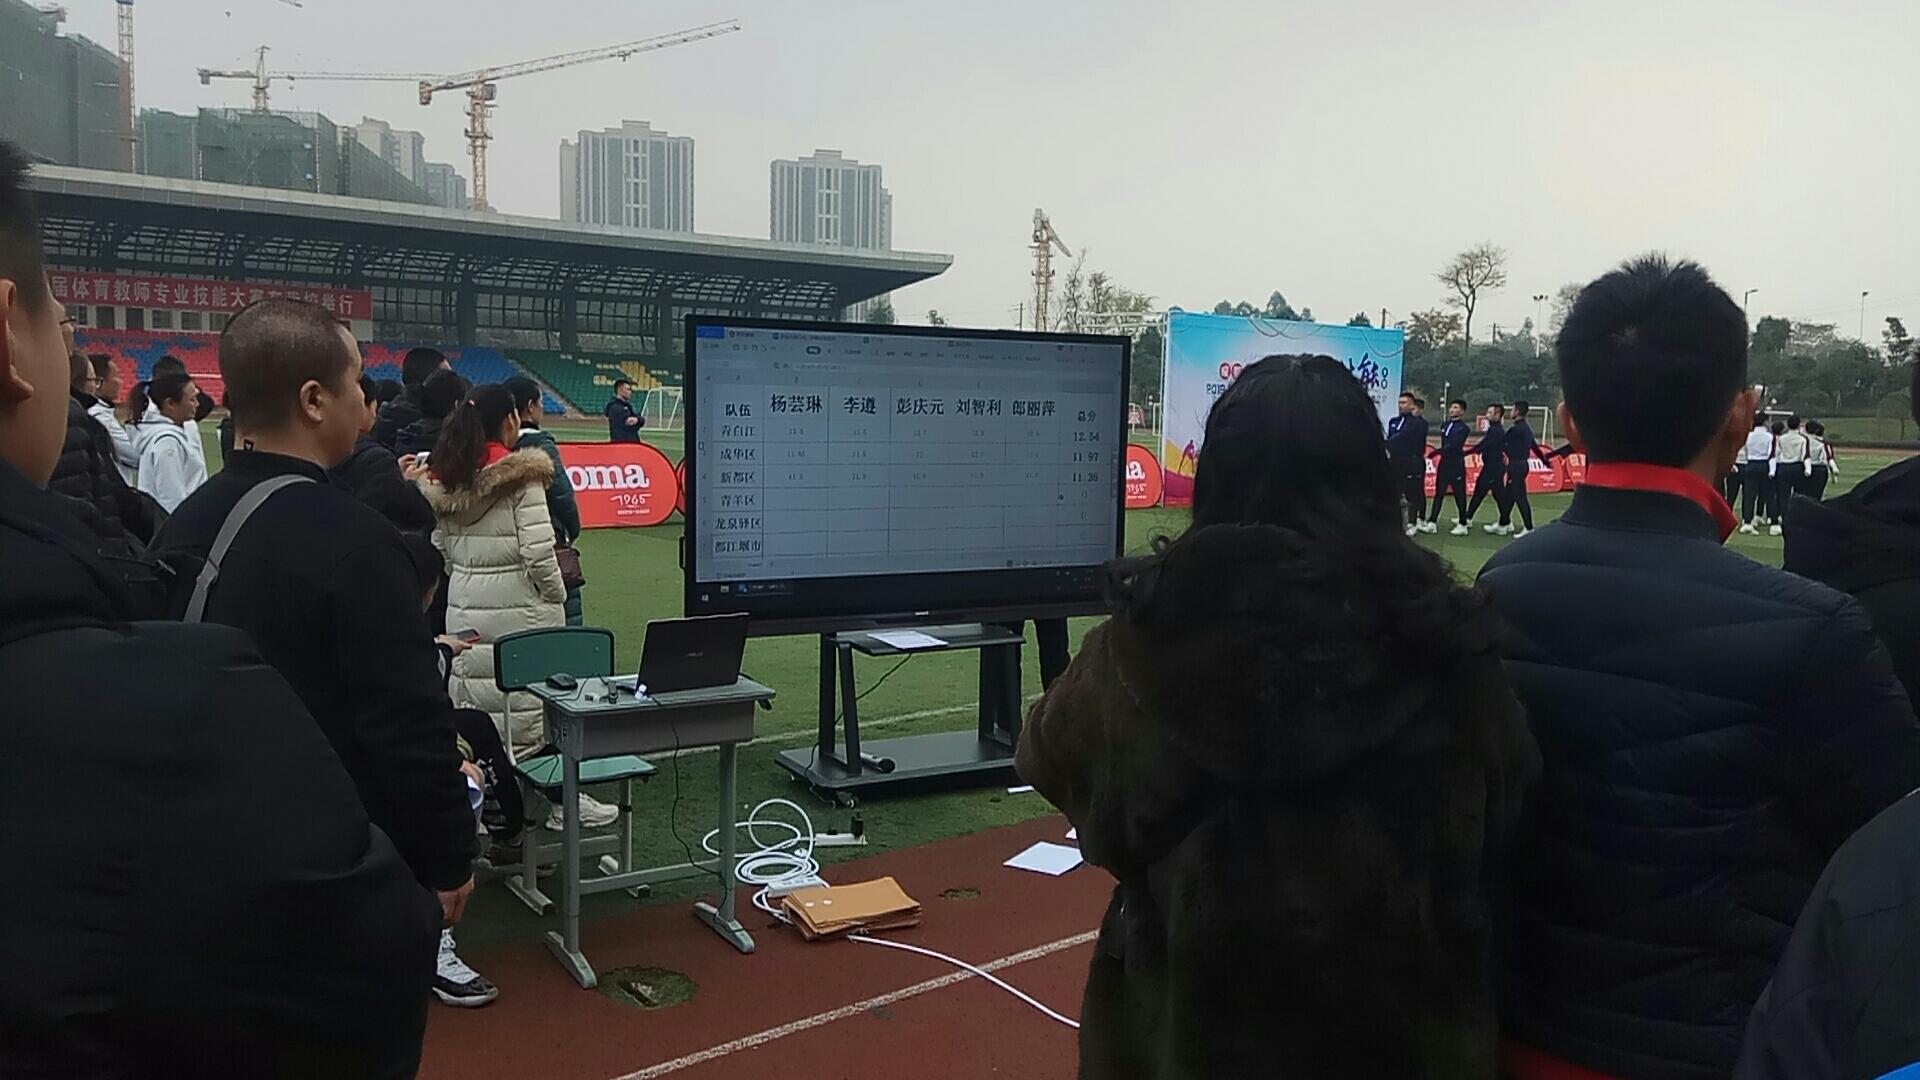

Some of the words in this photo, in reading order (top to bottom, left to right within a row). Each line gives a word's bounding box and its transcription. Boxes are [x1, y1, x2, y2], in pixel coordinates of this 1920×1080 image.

[725, 403, 752, 417] 队伍
[770, 393, 823, 414] 杨芸琳
[896, 397, 945, 416] 彭庆元
[956, 398, 1002, 416] 刘智利
[720, 447, 755, 461] 成华区
[721, 471, 755, 484] 新都区
[1126, 461, 1146, 480] a
